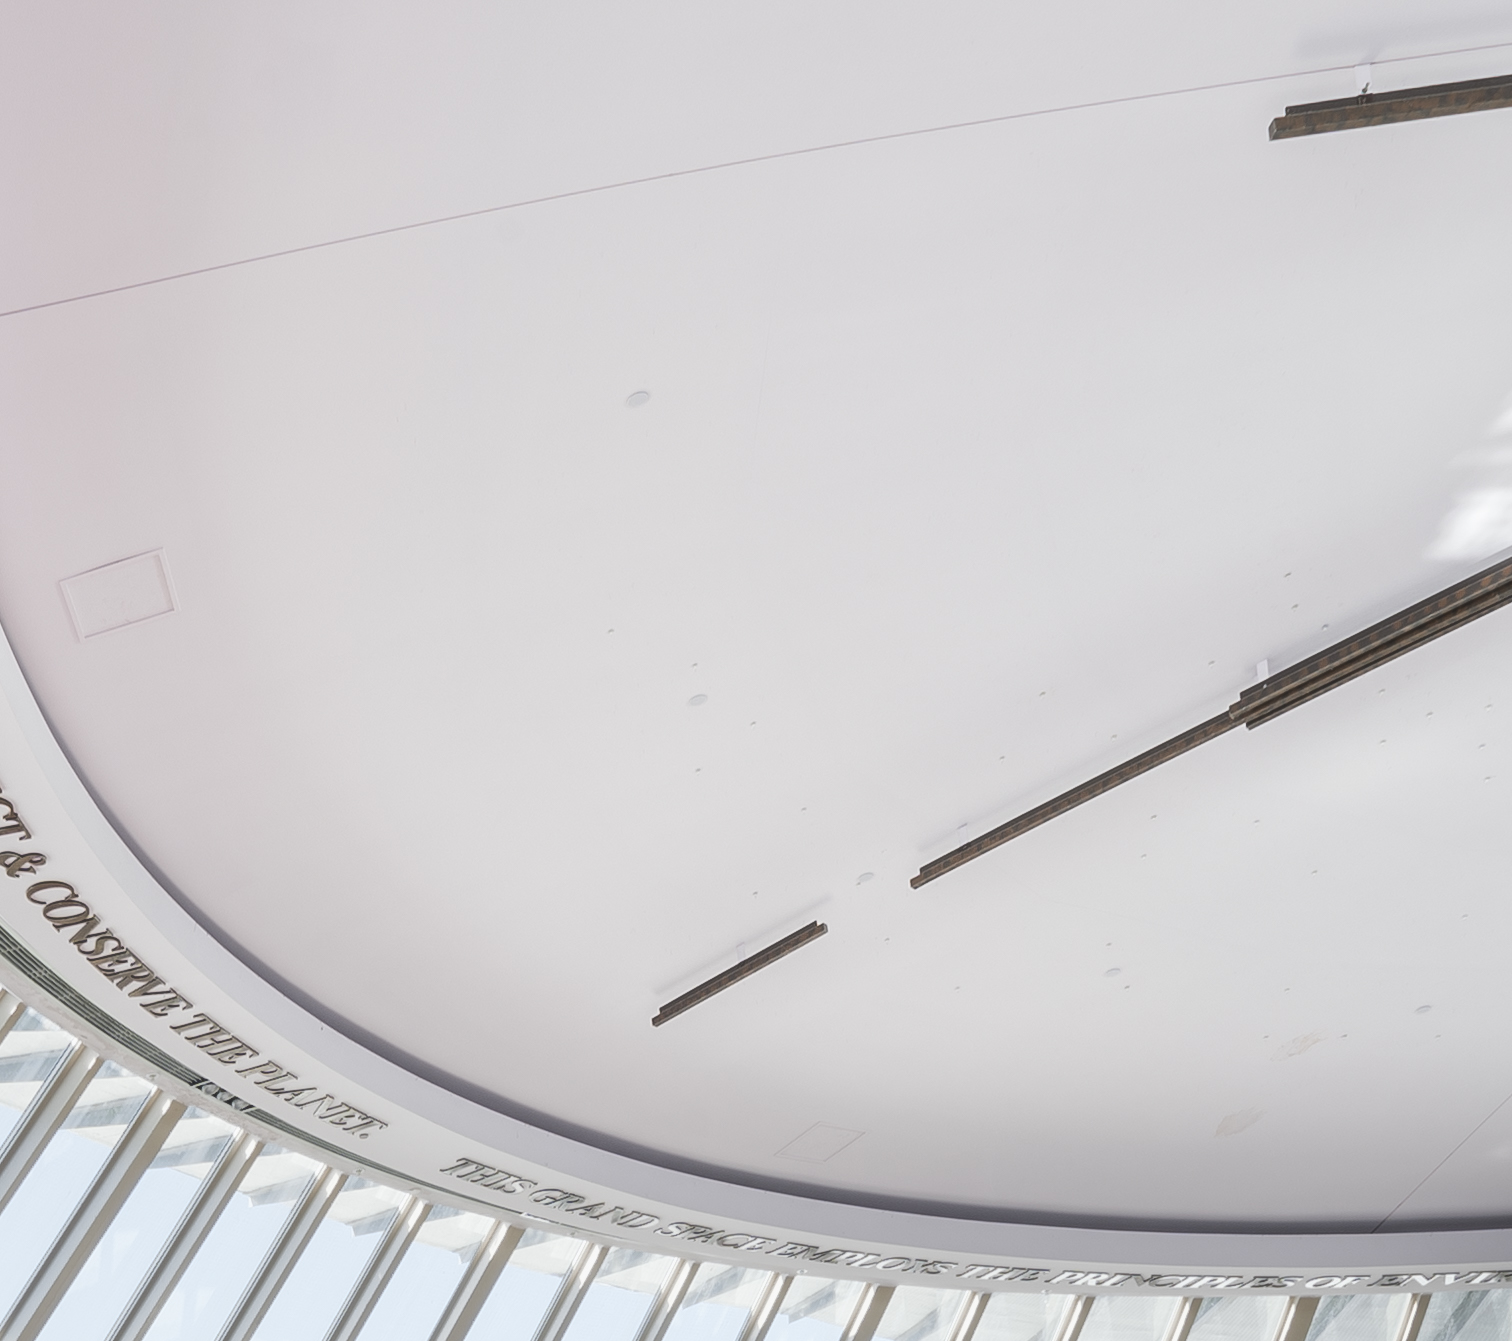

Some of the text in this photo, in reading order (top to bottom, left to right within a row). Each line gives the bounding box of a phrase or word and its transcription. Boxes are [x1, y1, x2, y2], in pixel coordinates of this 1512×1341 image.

[26, 881, 194, 1018] CONSERVE
[170, 1013, 260, 1066] THE
[236, 1060, 389, 1139] PLANET.
[440, 1157, 538, 1195] THIS
[528, 1187, 660, 1231] GRAND
[654, 1219, 777, 1256] SPACE
[771, 1242, 958, 1275] EMPLOYS
[957, 1263, 1050, 1282] THE
[1046, 1269, 1306, 1290] PRINCIPLES
[1304, 1274, 1374, 1290] OF
